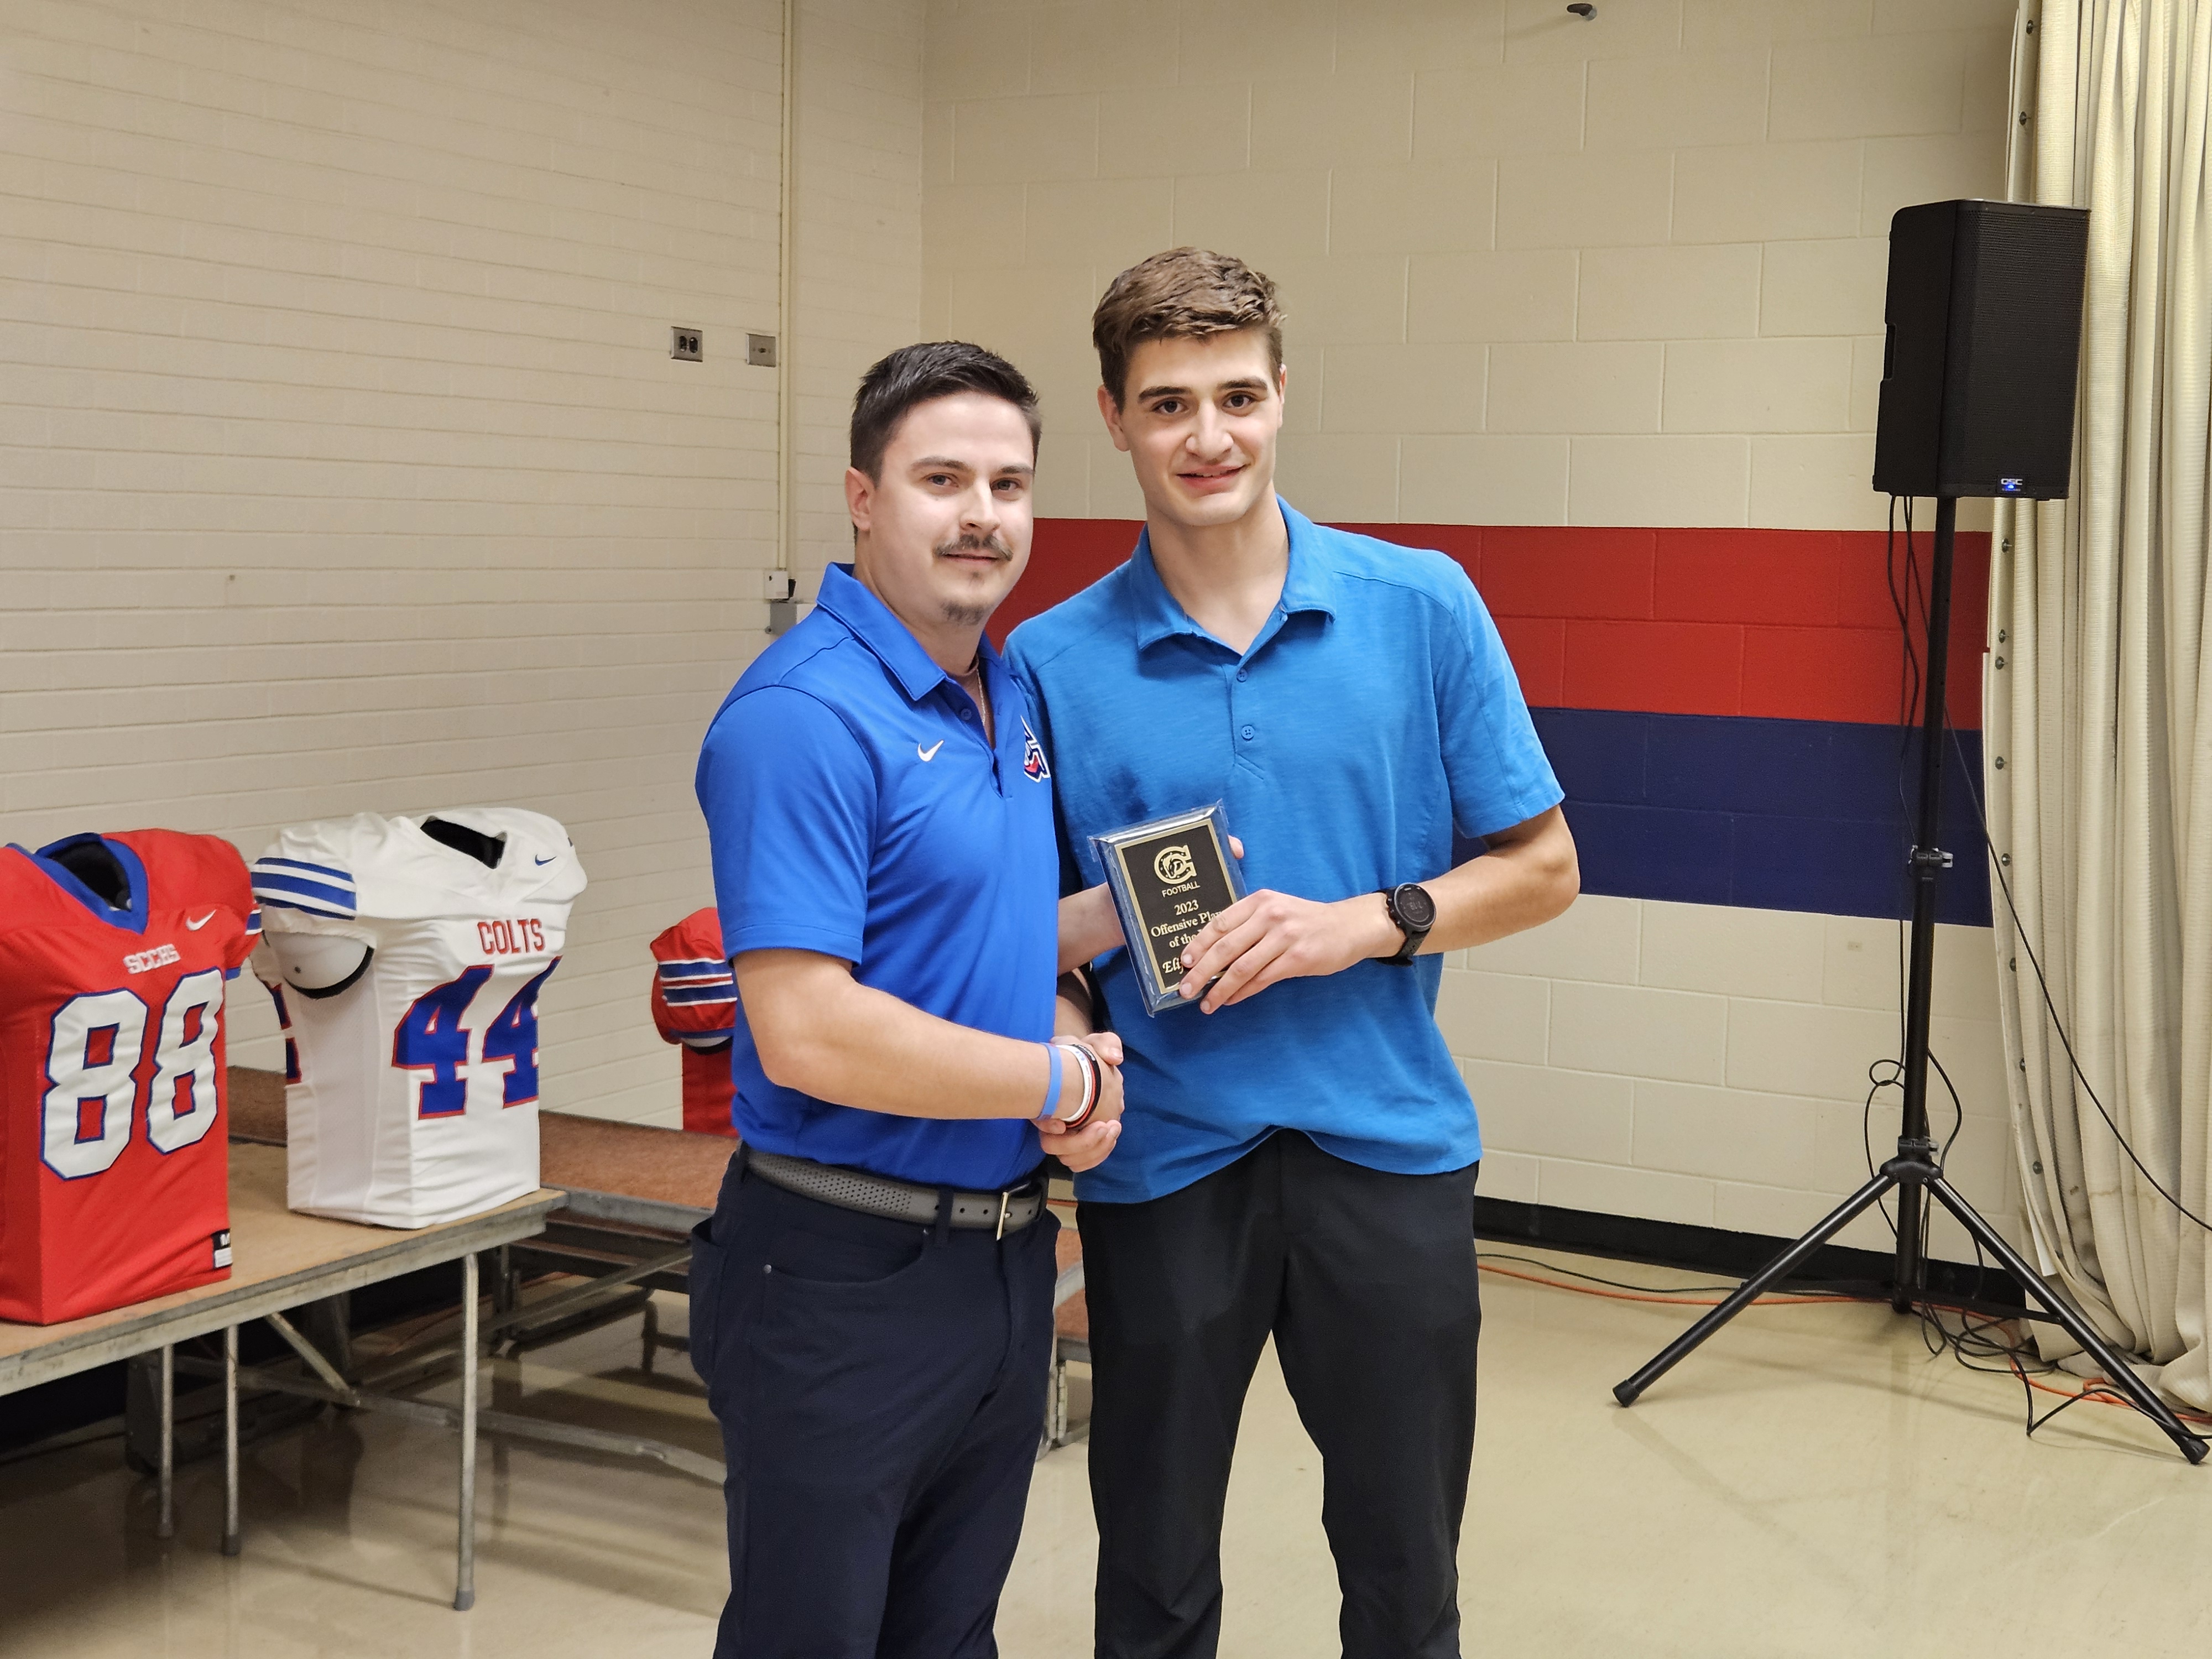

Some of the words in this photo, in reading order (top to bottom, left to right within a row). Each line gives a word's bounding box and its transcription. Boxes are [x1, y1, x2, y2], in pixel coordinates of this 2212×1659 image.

[1161, 880, 1201, 898] FOOTBALL
[1174, 899, 1199, 916] 2023
[477, 918, 546, 954] COLTS
[1150, 918, 1198, 937] Offensive
[1169, 936, 1180, 948] of
[123, 943, 181, 974] SCCHS
[392, 956, 562, 1121] 44
[40, 967, 224, 1181] 88
